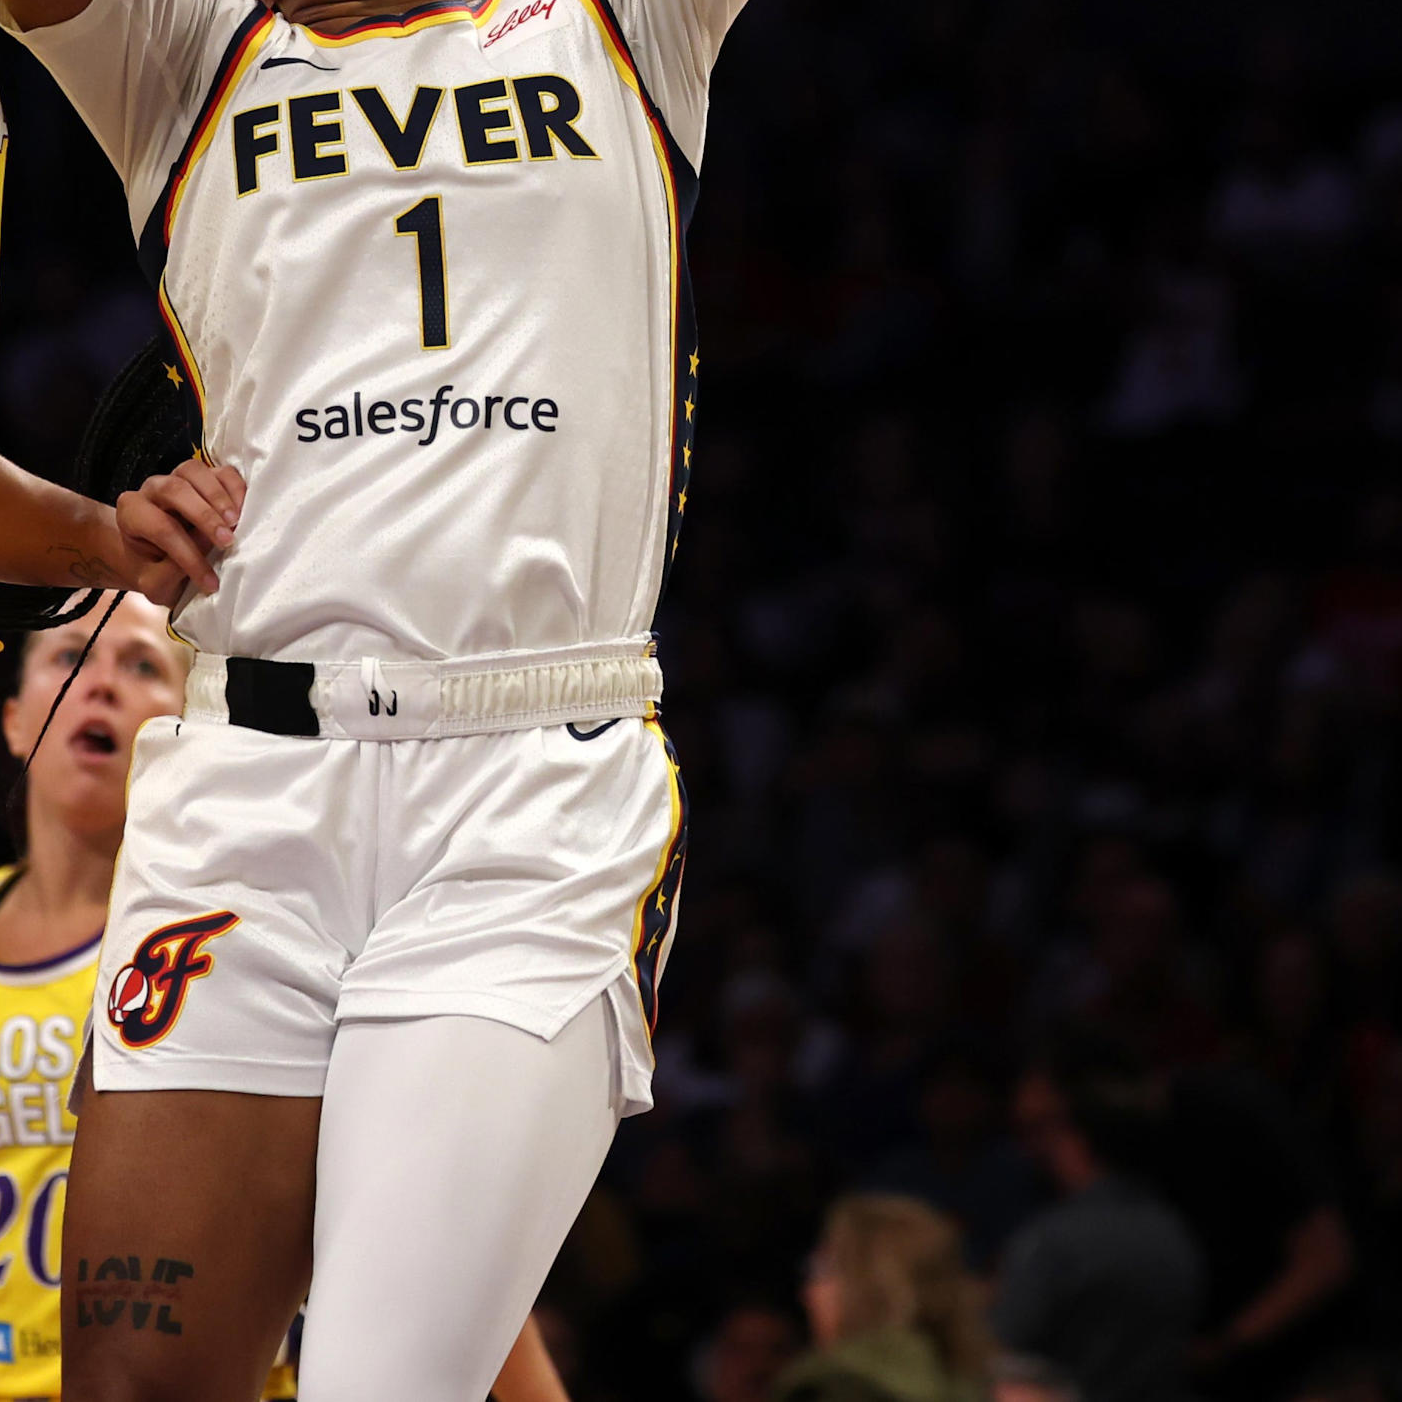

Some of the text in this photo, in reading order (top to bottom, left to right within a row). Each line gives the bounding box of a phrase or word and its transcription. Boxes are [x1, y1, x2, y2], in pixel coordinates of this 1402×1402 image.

[231, 73, 602, 200] FEVER
[393, 194, 451, 350] 1
[296, 385, 559, 446] salesforce
